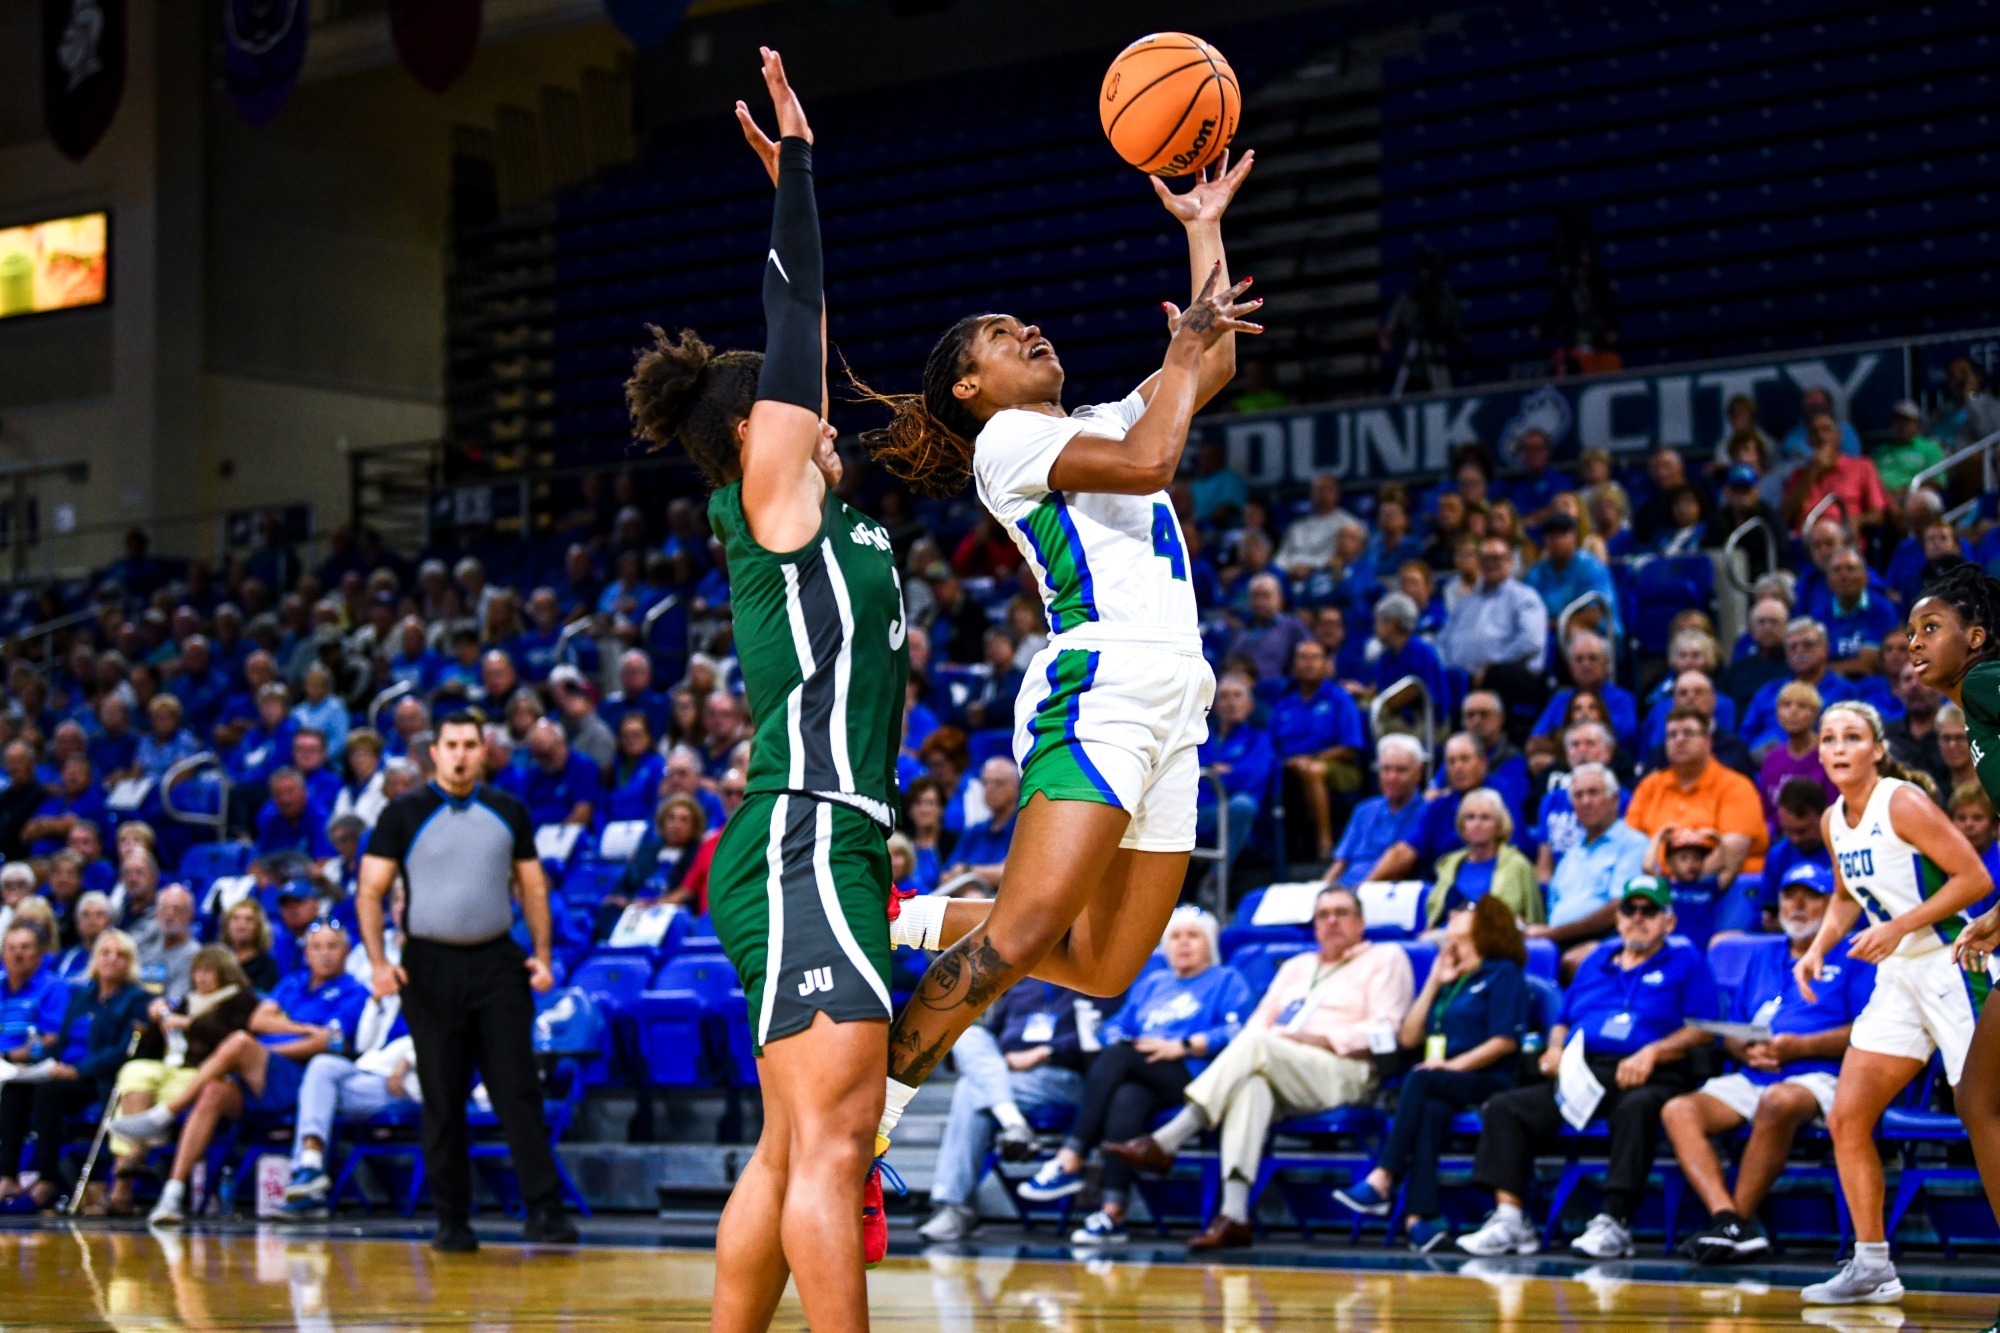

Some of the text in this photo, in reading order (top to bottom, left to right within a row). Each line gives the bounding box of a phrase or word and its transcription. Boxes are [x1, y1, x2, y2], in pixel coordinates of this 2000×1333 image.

[1150, 118, 1217, 176] Wilson
[1227, 354, 1880, 486] DUNK CITY
[1151, 502, 1188, 581] 4
[798, 965, 834, 997] JU
